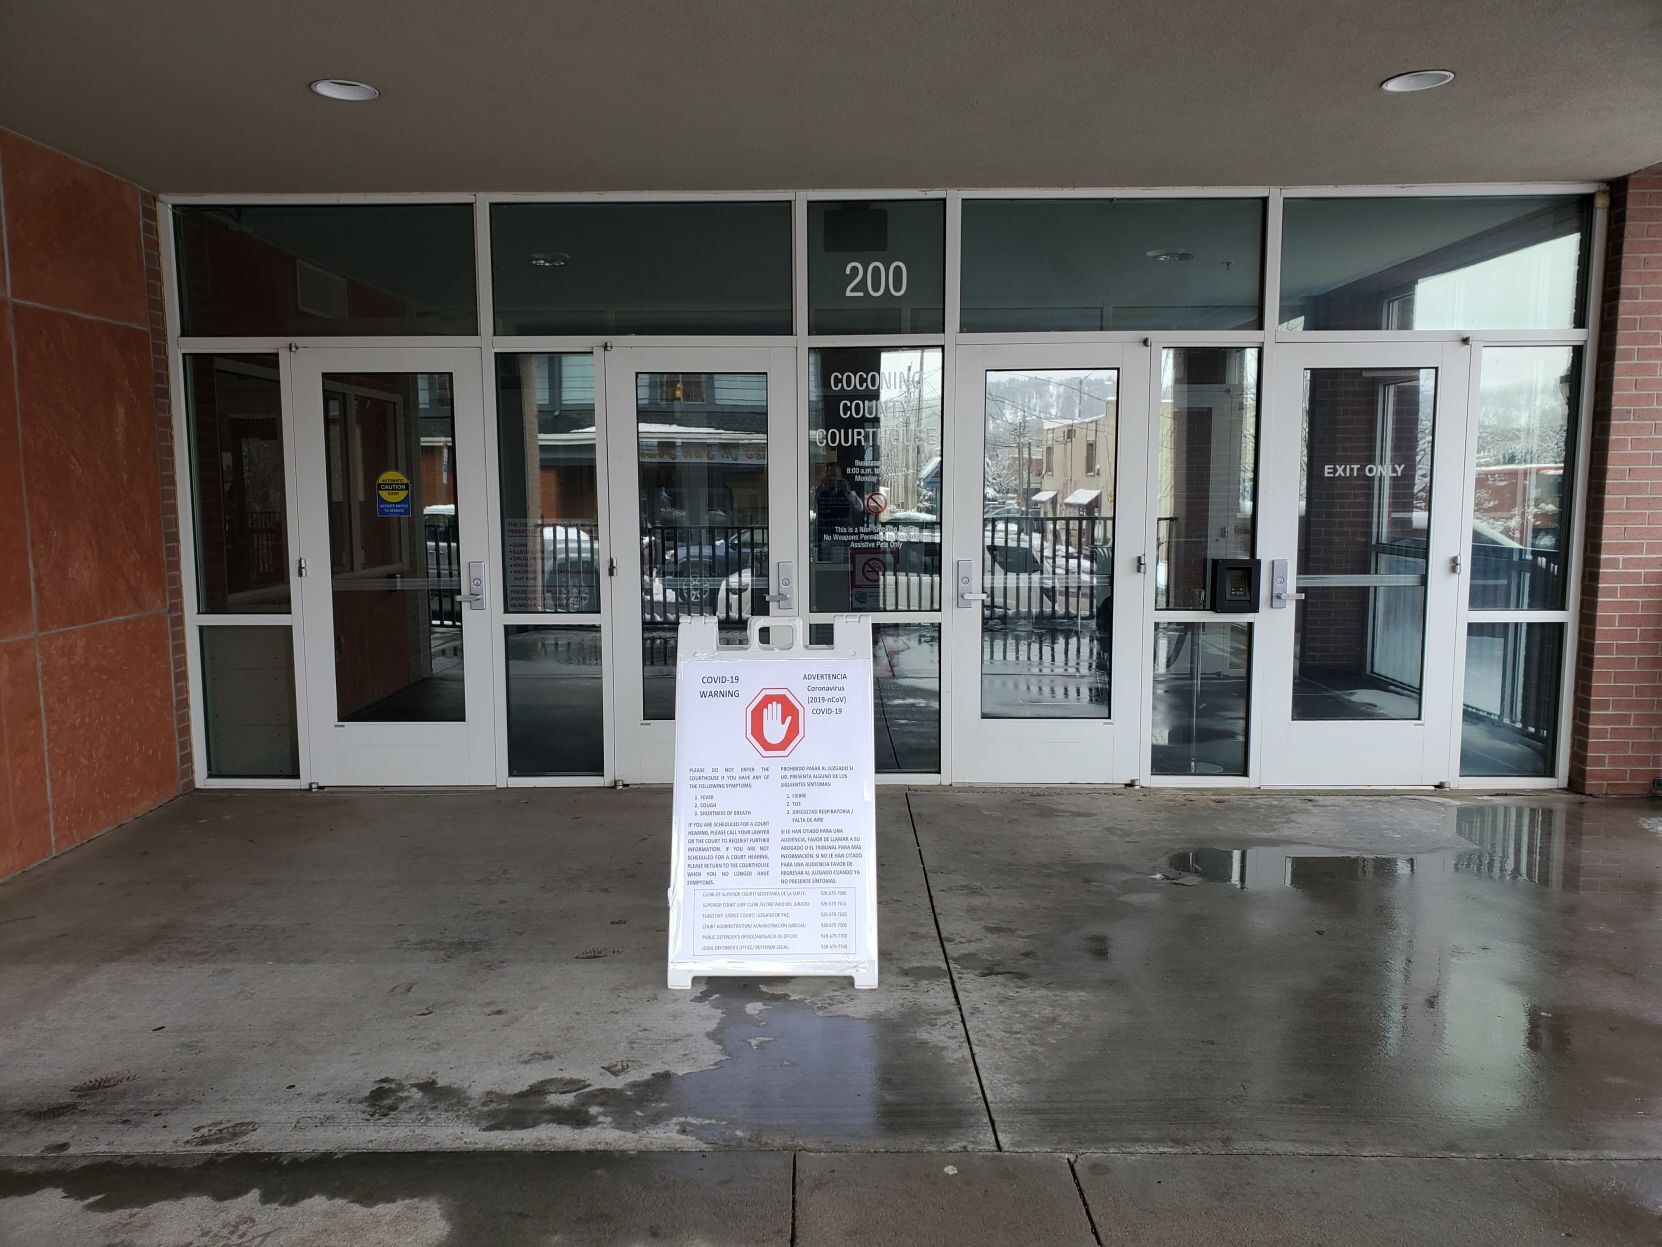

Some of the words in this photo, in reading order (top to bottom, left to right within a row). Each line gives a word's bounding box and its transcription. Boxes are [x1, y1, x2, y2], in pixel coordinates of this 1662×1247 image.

[846, 261, 907, 297] 200
[830, 371, 923, 390] COCONINO
[840, 399, 911, 418] COUNTY
[816, 427, 936, 446] COURTHOUSE
[1324, 465, 1360, 477] EXIT
[1365, 464, 1405, 477] ONLY
[702, 675, 739, 684] COVID-19
[699, 690, 740, 698] WARNING
[807, 696, 846, 704] (2019-nCoV)
